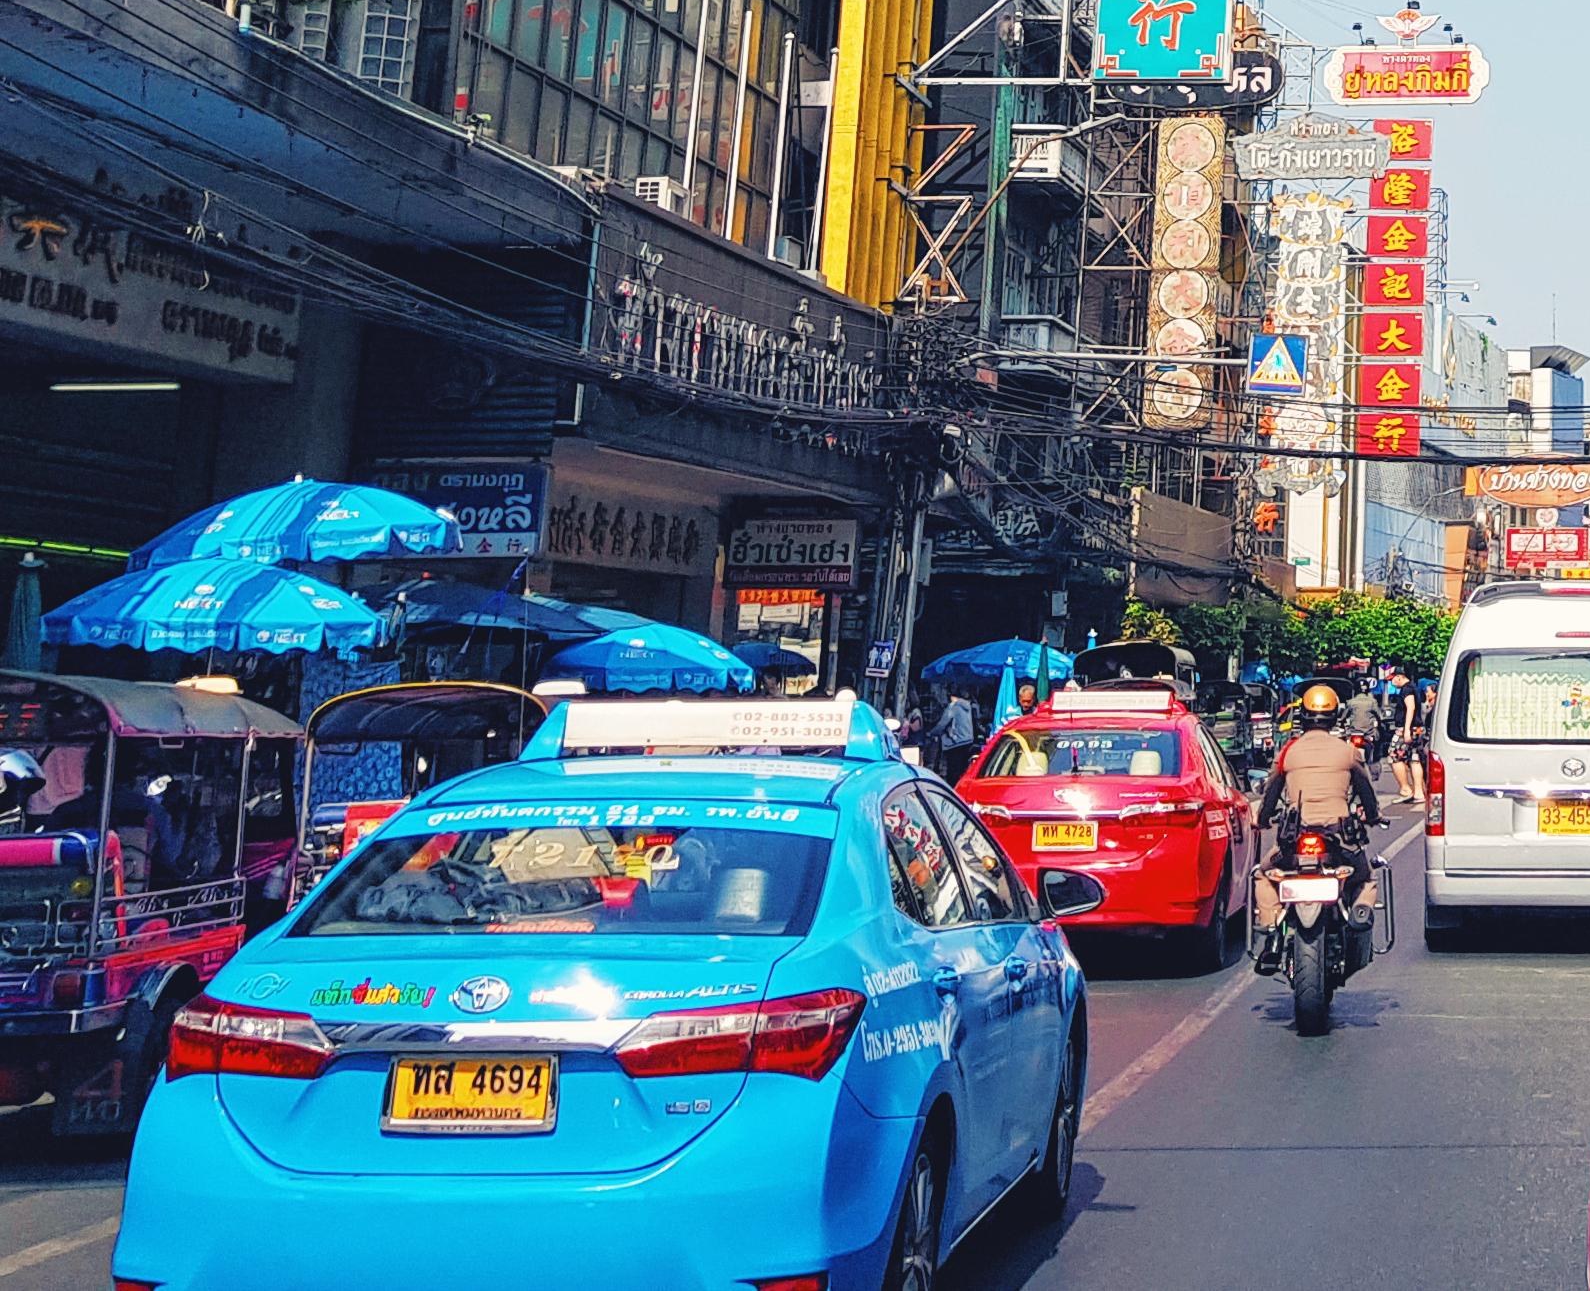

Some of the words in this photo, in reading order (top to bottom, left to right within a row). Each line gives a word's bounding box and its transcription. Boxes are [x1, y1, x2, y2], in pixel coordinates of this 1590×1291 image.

[742, 726, 843, 737] 02-951-3030
[606, 803, 640, 817] 24
[1064, 824, 1093, 839] 4728
[685, 981, 759, 999] ALTIS
[411, 1063, 456, 1095] ทส
[470, 1064, 543, 1095] 4694
